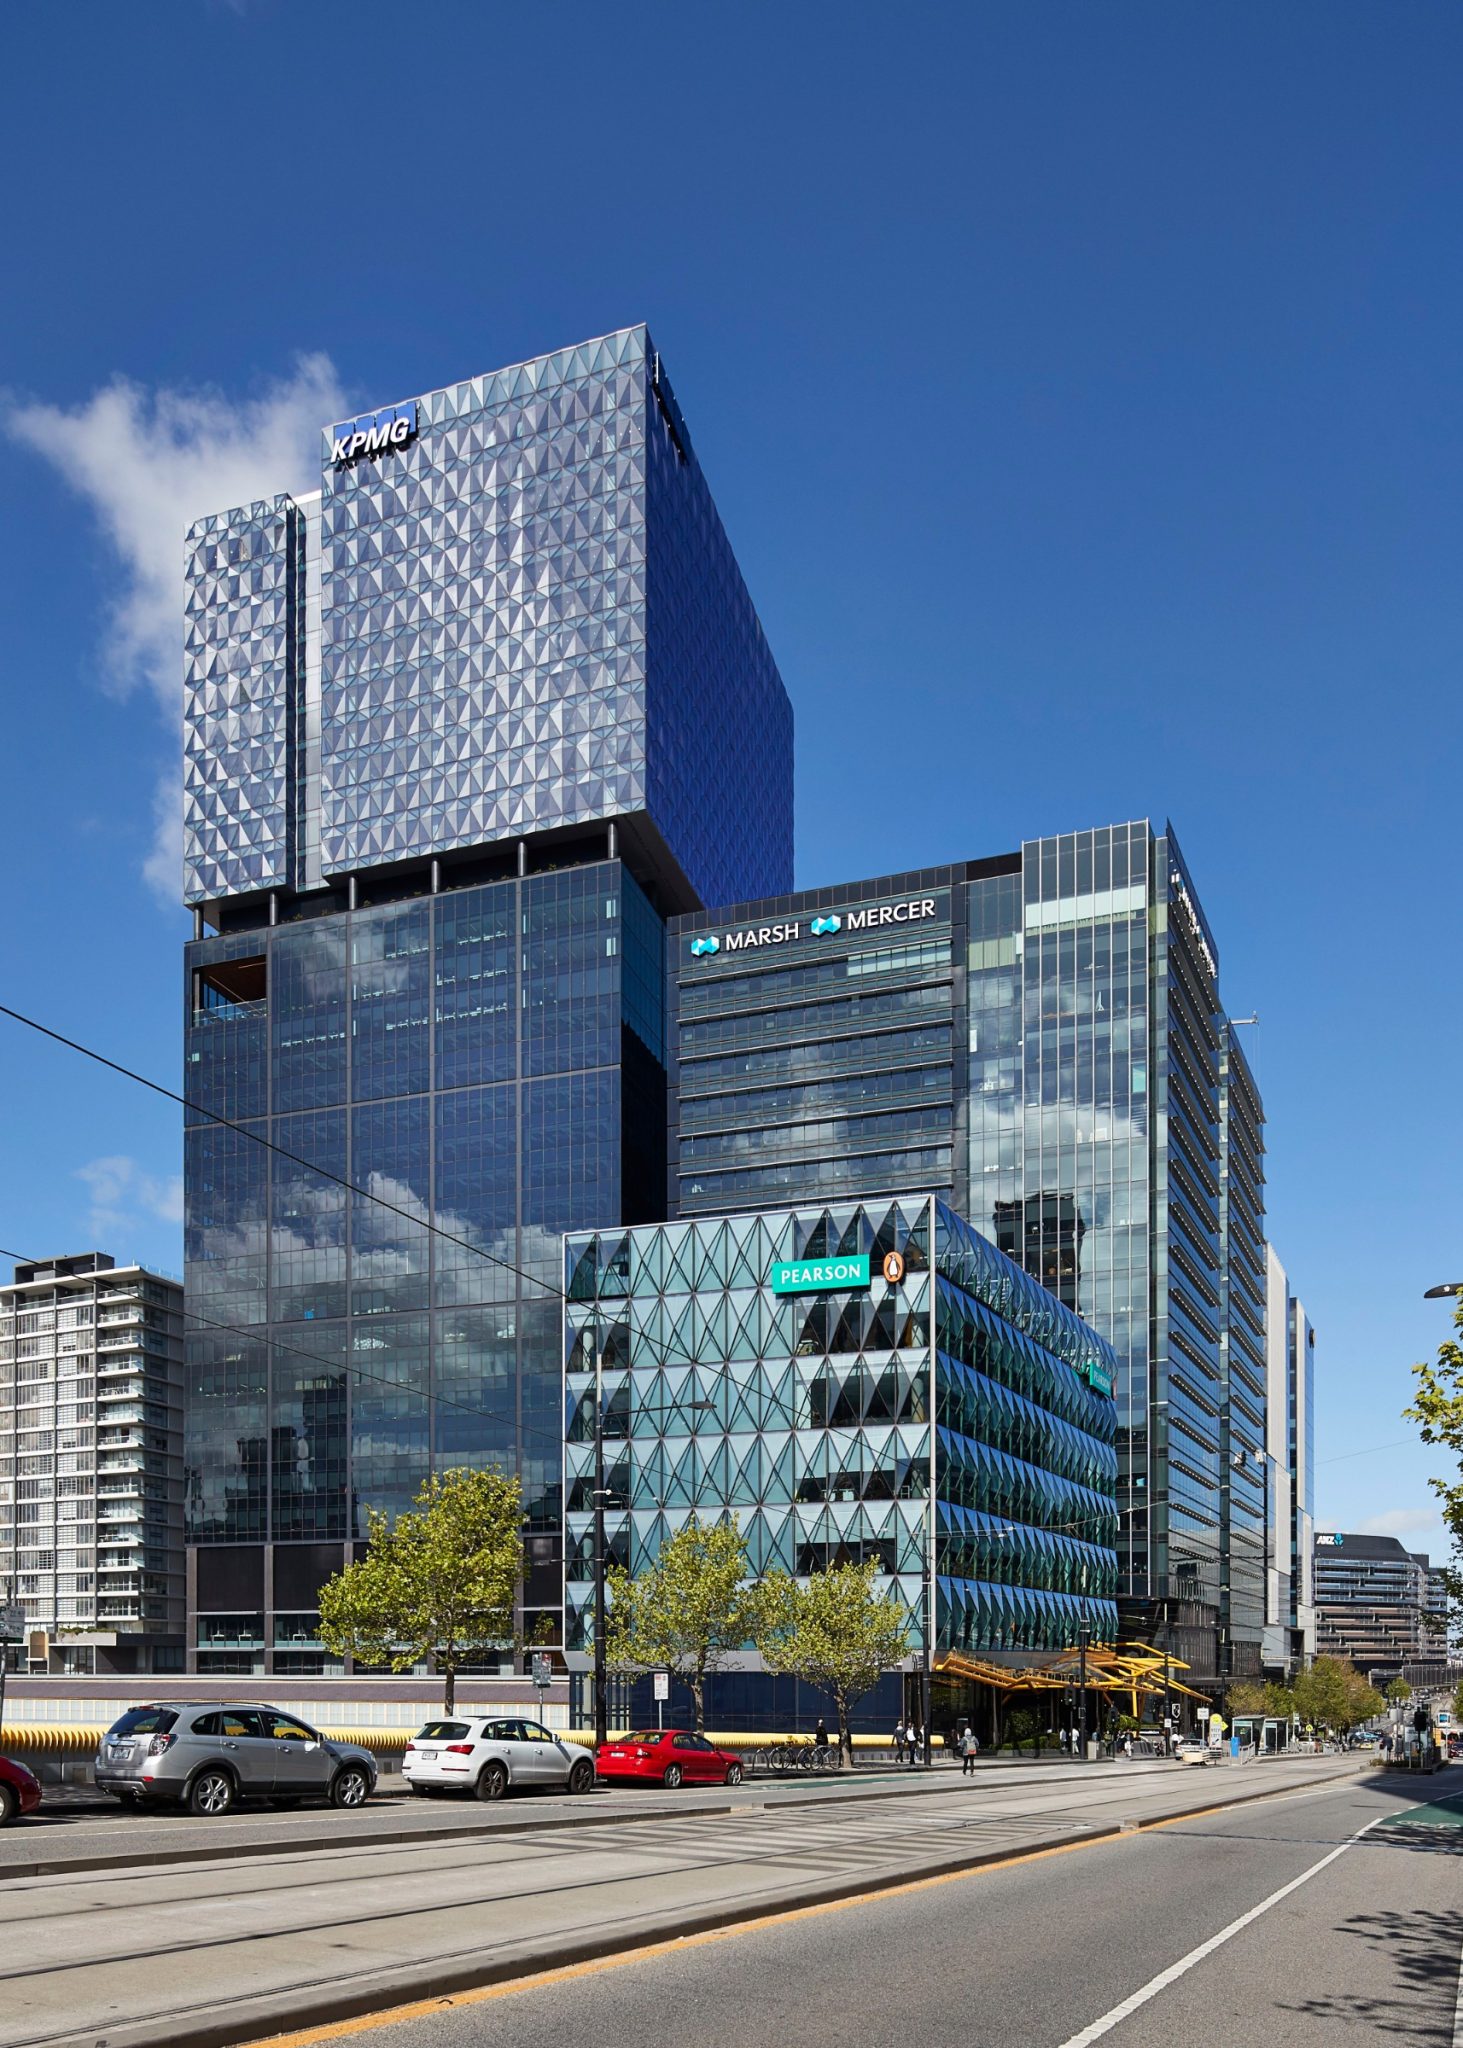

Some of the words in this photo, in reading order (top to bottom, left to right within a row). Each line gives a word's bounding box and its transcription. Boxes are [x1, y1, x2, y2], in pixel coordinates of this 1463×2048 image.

[330, 417, 410, 463] KPMG
[847, 899, 936, 930] MERCER
[725, 923, 799, 951] MARSH
[781, 1264, 861, 1284] PEARSON
